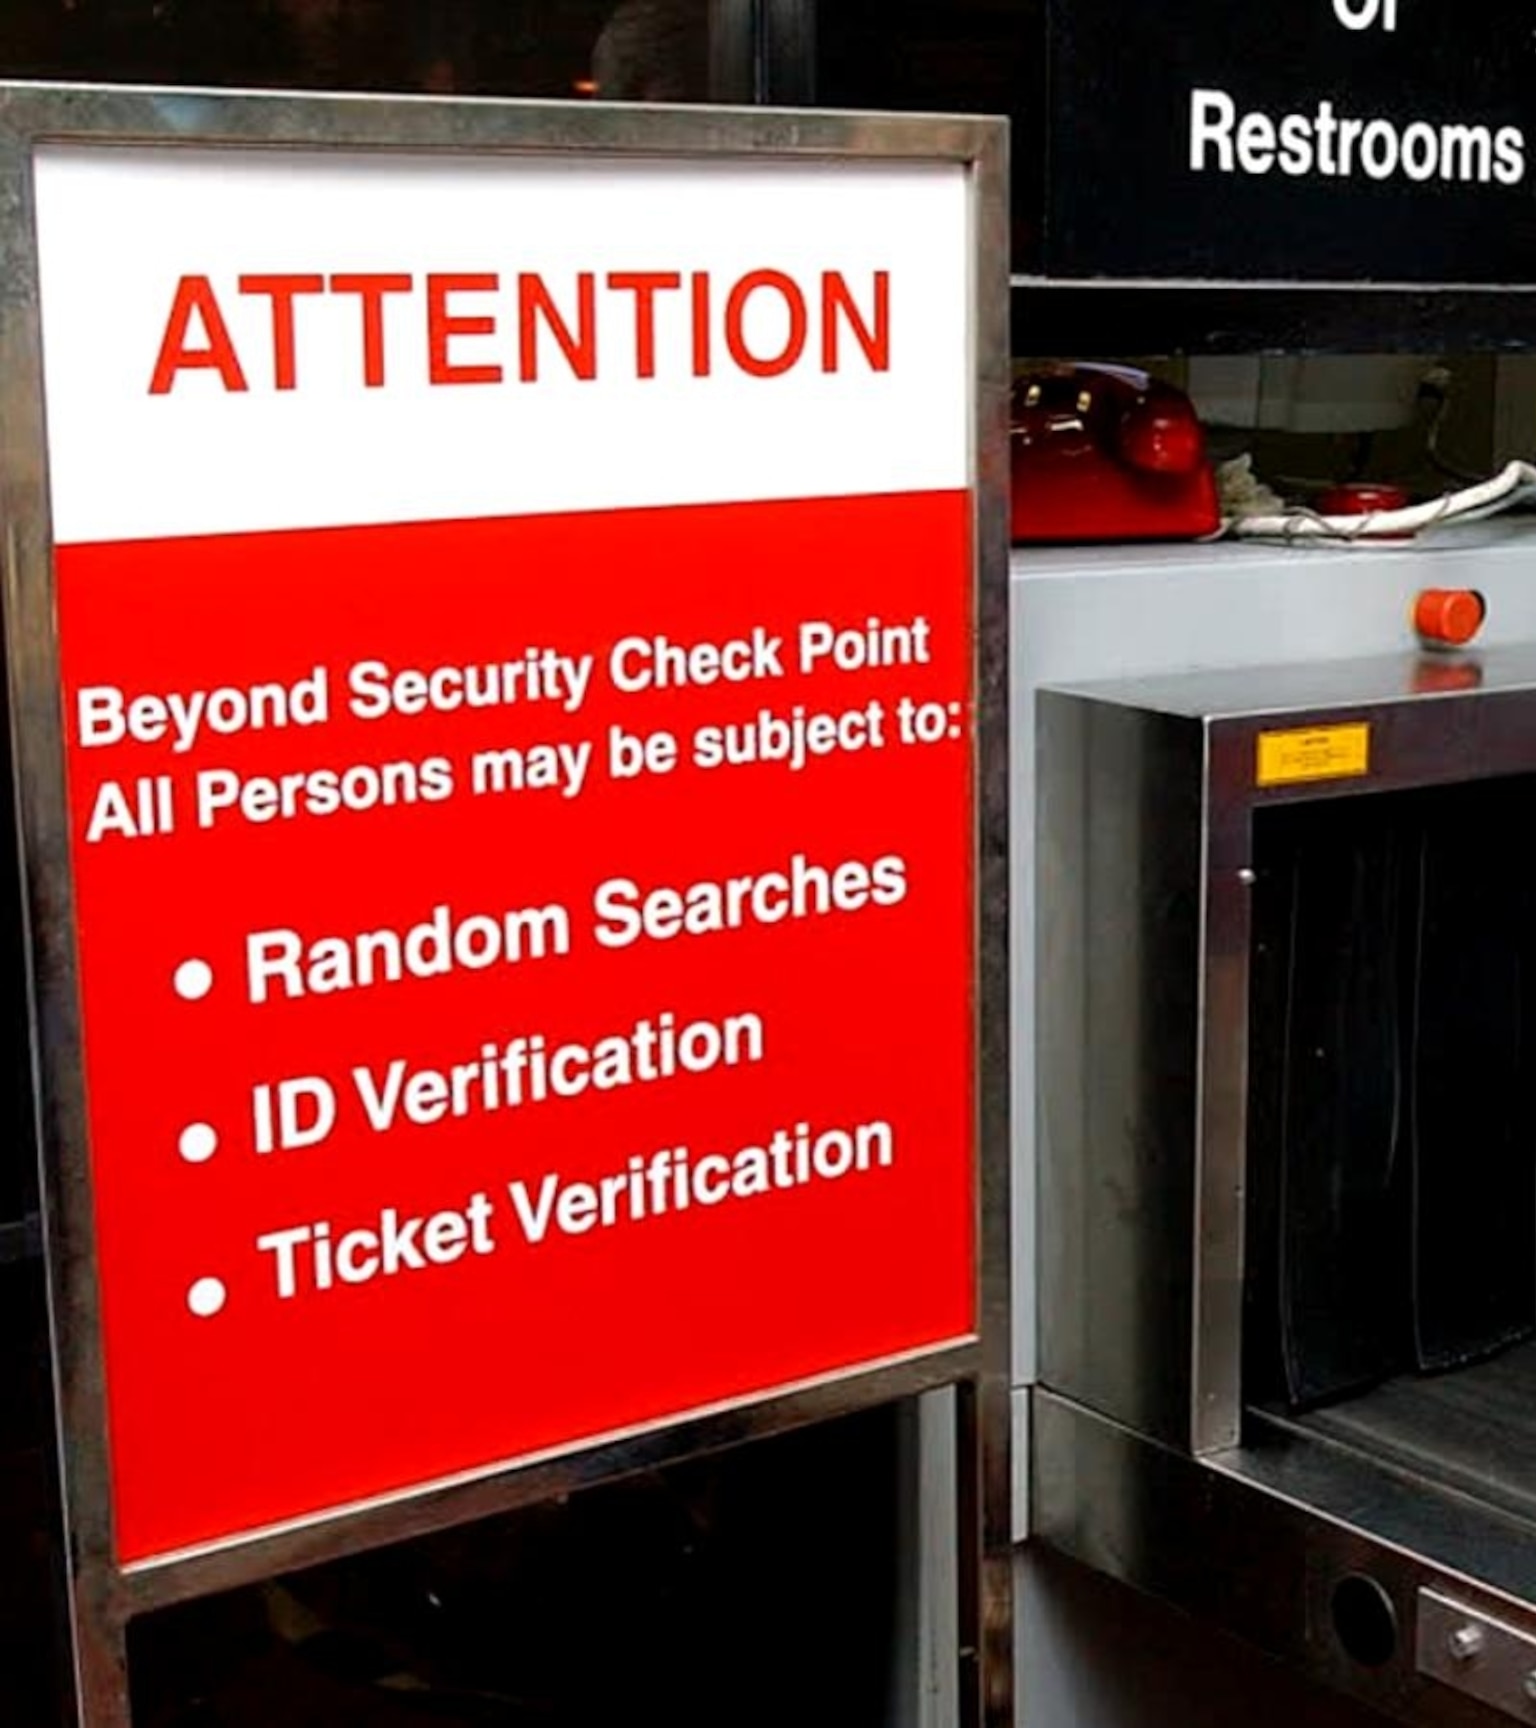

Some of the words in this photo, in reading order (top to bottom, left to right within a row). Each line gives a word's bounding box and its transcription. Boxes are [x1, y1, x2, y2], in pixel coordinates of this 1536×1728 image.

[1189, 88, 1525, 185] Restrooms
[148, 270, 891, 395] ATTENTION
[77, 666, 328, 754] Beyond
[348, 646, 592, 712] Security
[609, 626, 783, 692] Check
[799, 615, 930, 673] Point
[86, 774, 174, 842] All
[197, 748, 453, 828] Persons
[471, 740, 592, 799] may
[608, 725, 677, 778] be
[692, 707, 884, 771] subject
[896, 697, 962, 744] to:
[246, 904, 569, 1004] Random
[592, 853, 908, 950] Searches
[252, 1076, 337, 1154] ID
[351, 1012, 764, 1132] Verification
[256, 1192, 495, 1299] Ticket
[507, 1121, 894, 1243] Verification
